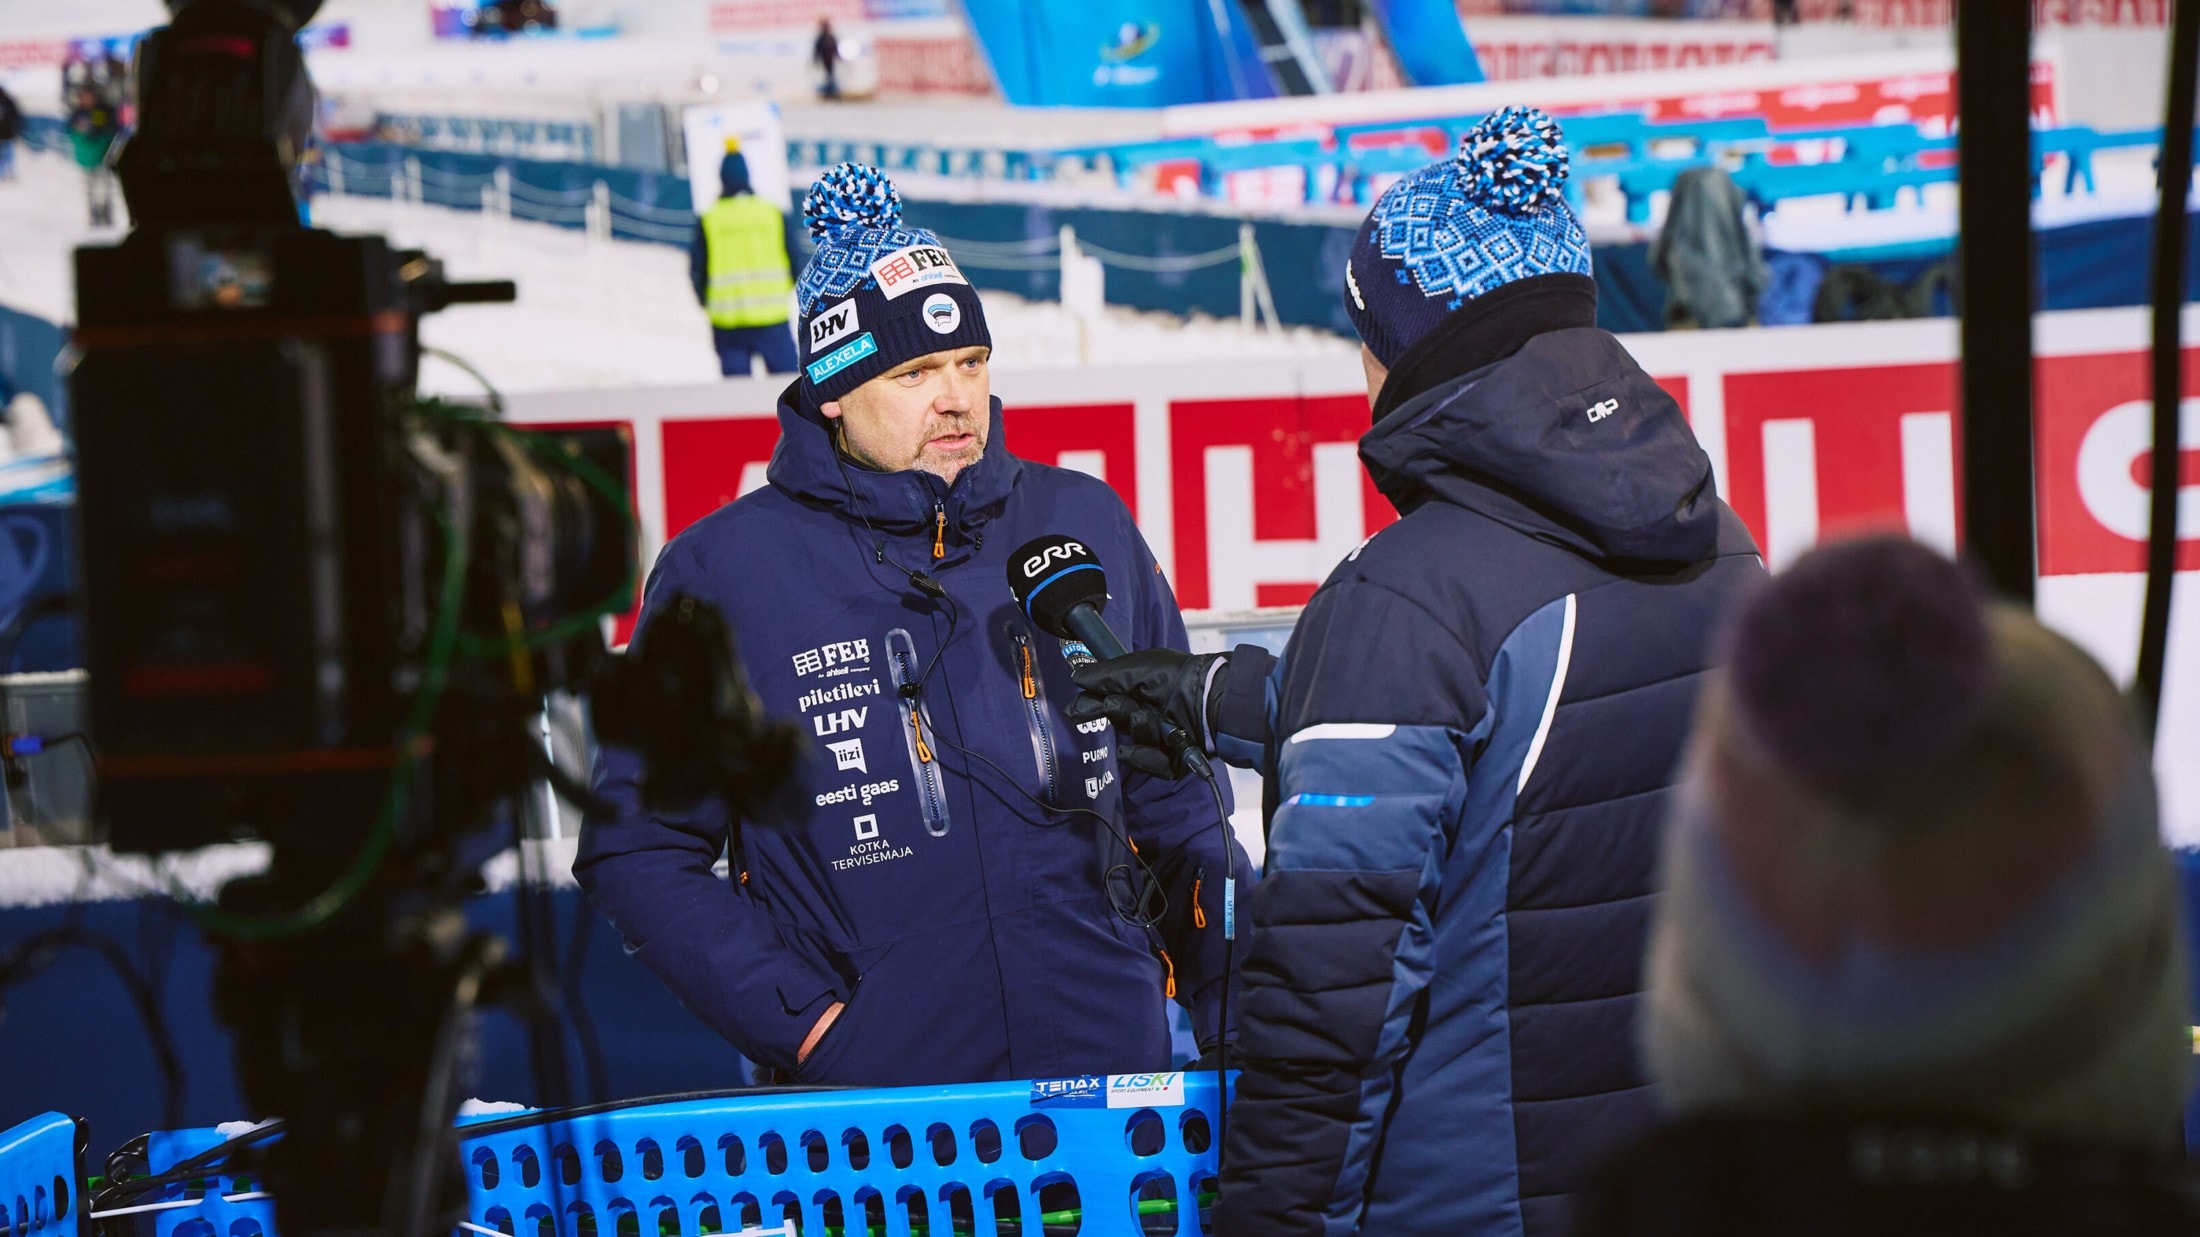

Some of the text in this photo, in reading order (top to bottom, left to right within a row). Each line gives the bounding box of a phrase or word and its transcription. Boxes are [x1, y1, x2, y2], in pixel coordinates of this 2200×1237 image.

[813, 309, 848, 344] LHV
[814, 339, 873, 379] ALEXELA
[822, 638, 870, 667] FEB
[799, 679, 880, 712] piletilevi
[814, 706, 868, 737] LHV
[838, 746, 861, 762] iizi
[1082, 746, 1109, 764] PURMO
[816, 779, 899, 806] eesti gaas
[831, 846, 913, 871] TERVISEMAJA
[850, 839, 890, 855] KOTKA
[1036, 1078, 1100, 1092] TENAX
[1113, 1073, 1177, 1088] LISKI
